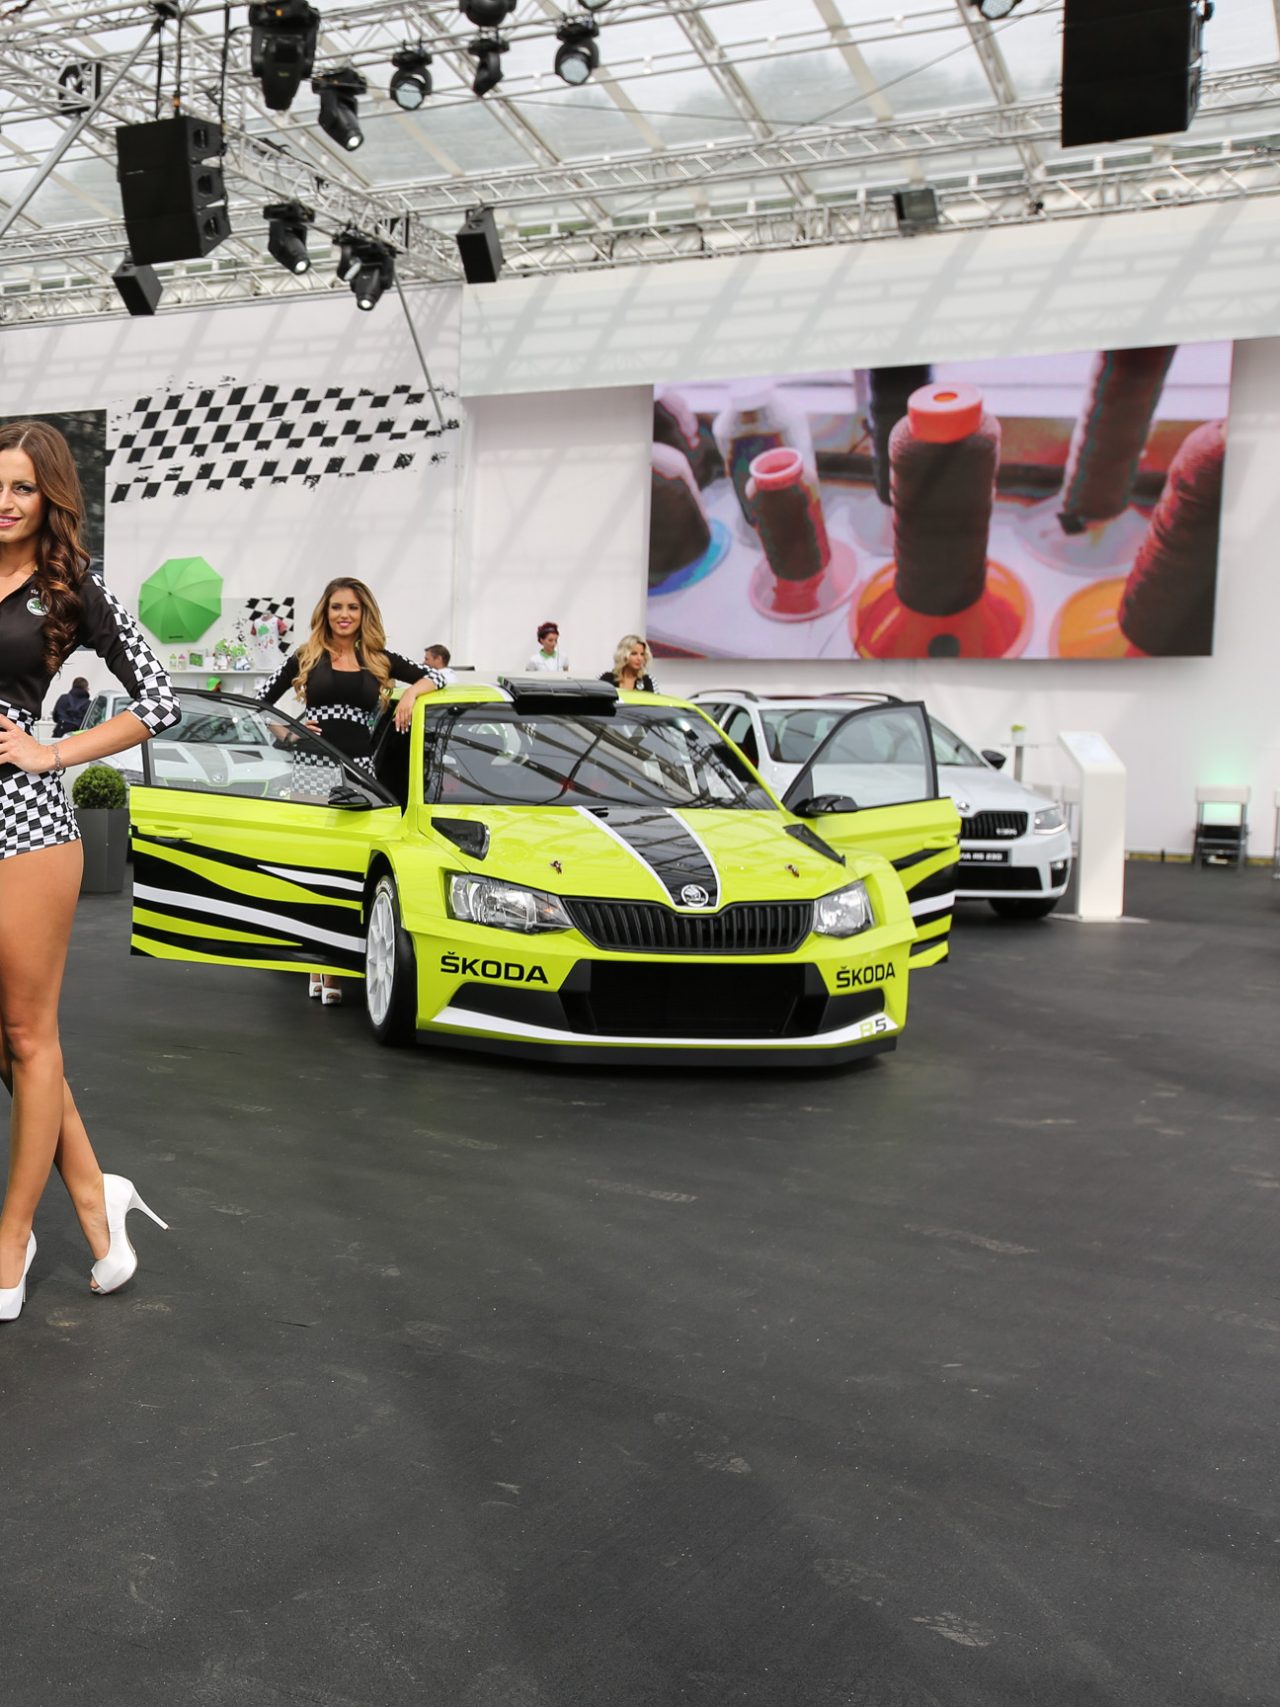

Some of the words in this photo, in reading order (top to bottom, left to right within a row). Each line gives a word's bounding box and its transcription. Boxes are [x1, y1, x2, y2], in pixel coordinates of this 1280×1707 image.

[440, 951, 549, 984] ŠKODA
[836, 962, 895, 988] ŠKODA
[860, 1017, 887, 1037] R5
